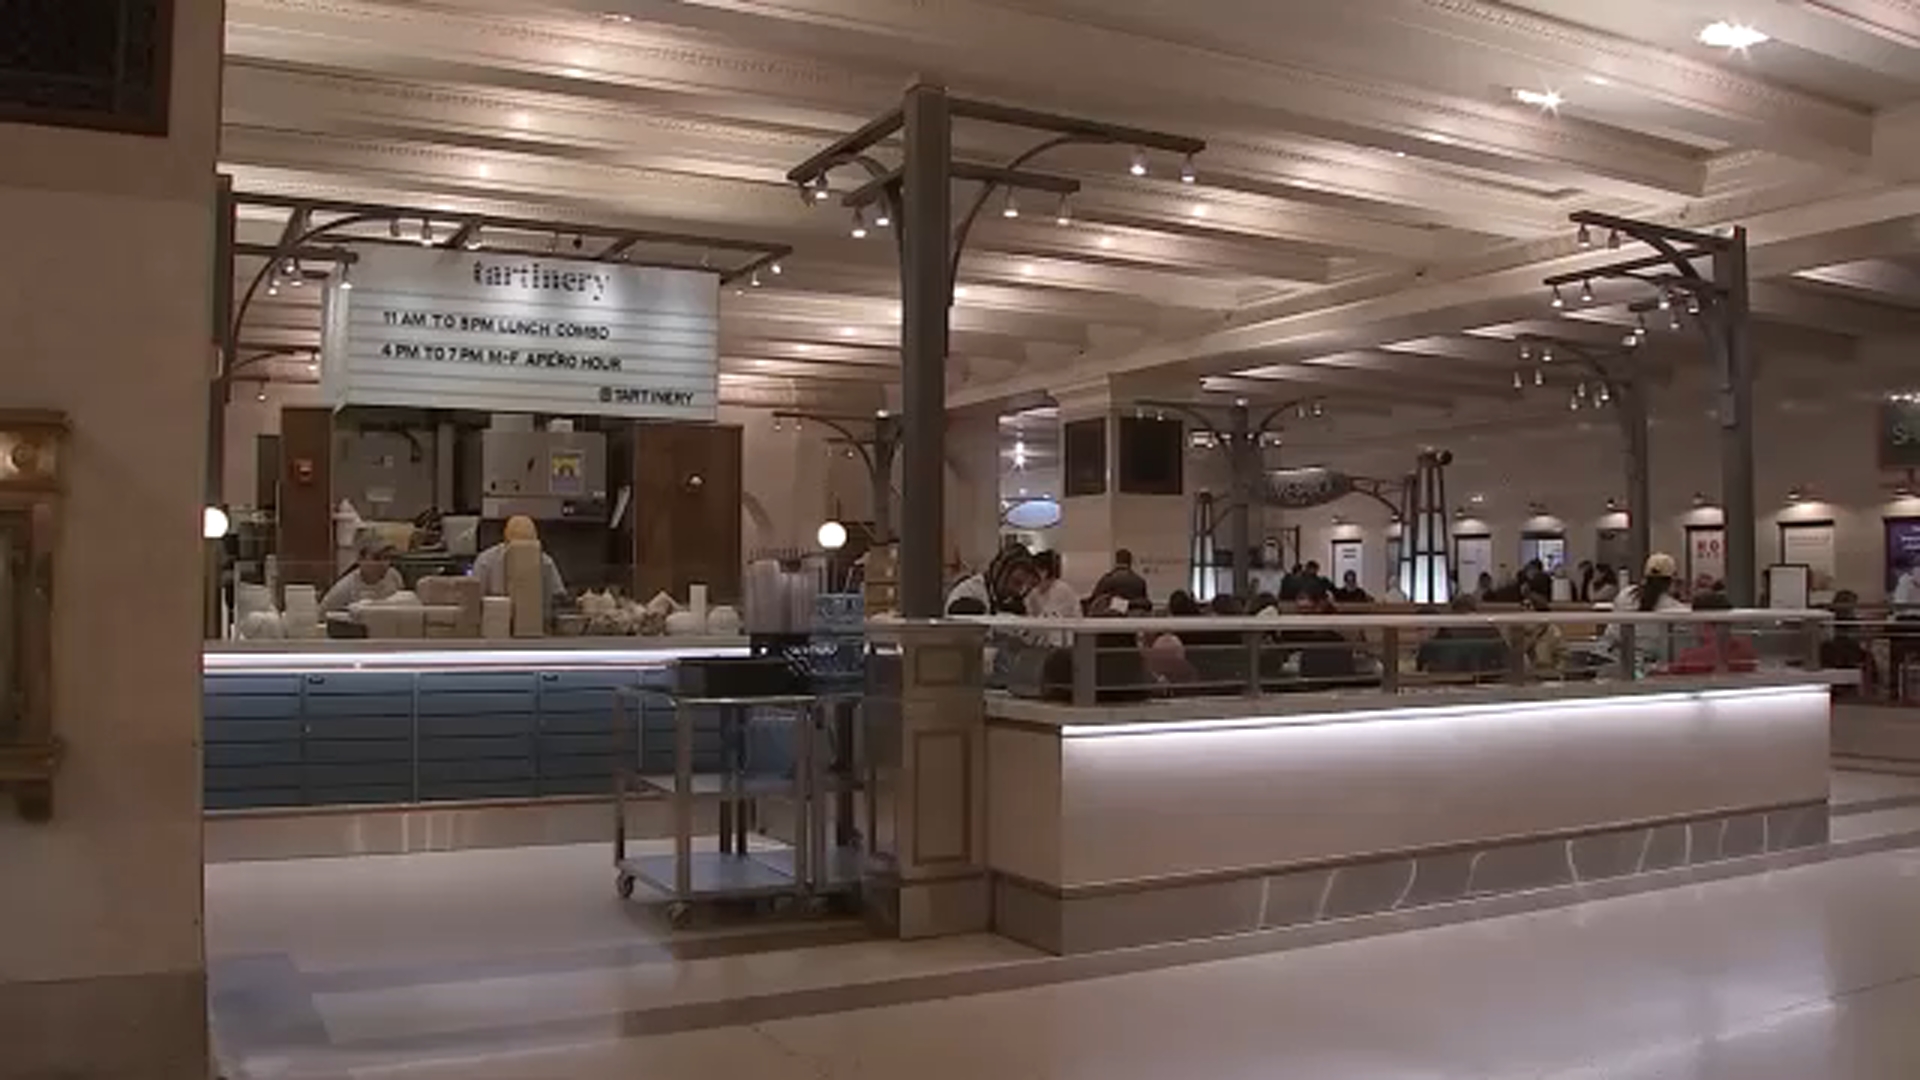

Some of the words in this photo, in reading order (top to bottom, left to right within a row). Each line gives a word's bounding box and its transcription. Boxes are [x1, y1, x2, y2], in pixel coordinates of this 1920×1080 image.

[474, 260, 610, 301] tartinery
[383, 311, 397, 325] 11
[401, 312, 426, 327] AM
[432, 313, 456, 329] TO
[499, 319, 550, 336] LUNCH
[556, 323, 610, 340] COMBO
[396, 344, 420, 359] PM
[425, 346, 445, 361] TO
[461, 347, 483, 362] PM
[582, 356, 622, 372] HOUR
